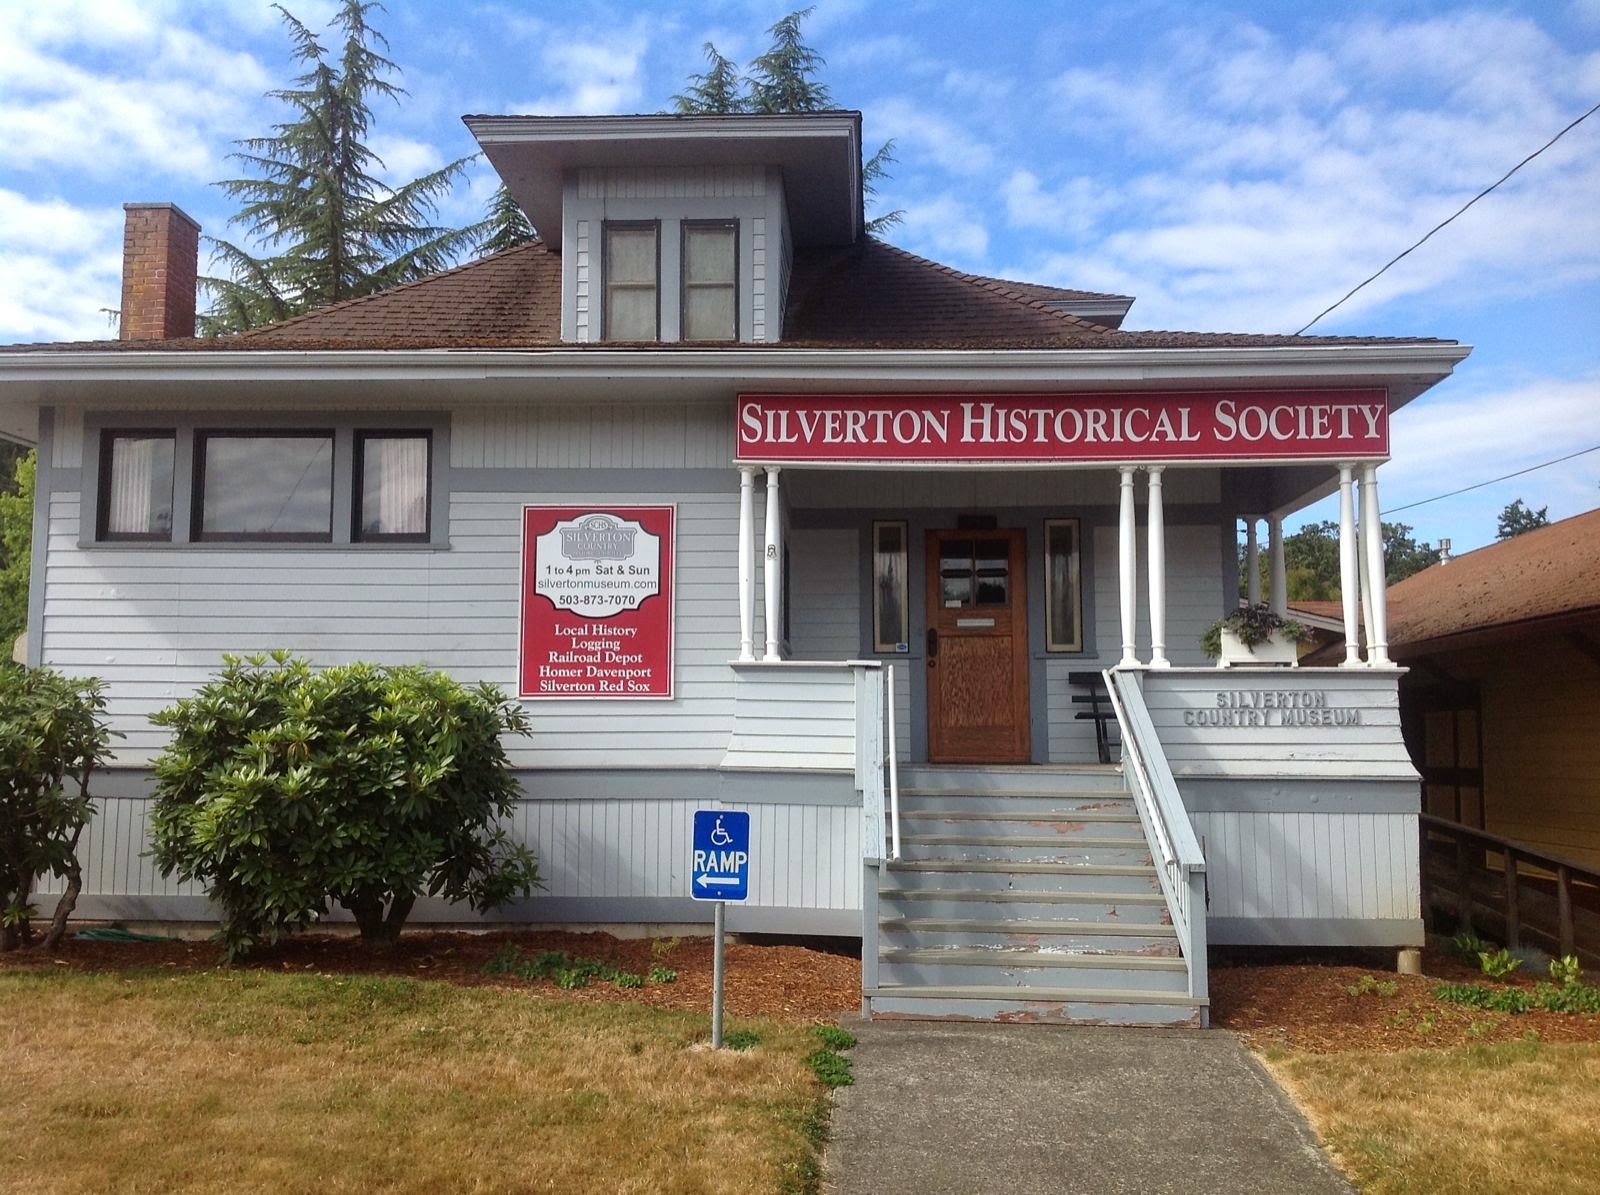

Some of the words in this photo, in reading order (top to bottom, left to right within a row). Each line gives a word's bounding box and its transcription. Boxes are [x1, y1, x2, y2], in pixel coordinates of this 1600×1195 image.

[741, 403, 950, 444] SILVERTON
[960, 402, 1200, 443] HISTORICAL
[1213, 400, 1384, 441] SOCIETY
[566, 533, 631, 541] SILVERTON
[546, 565, 551, 575] 1
[555, 567, 564, 575] to
[566, 565, 573, 575] 4
[575, 568, 590, 576] pm
[595, 565, 613, 575] Sat
[617, 565, 625, 575] &
[628, 565, 650, 575] Sun
[538, 579, 657, 589] silvertonmuseum.com
[559, 595, 635, 605] 503-873-7070
[555, 624, 588, 636] Local
[592, 624, 637, 638] History
[572, 637, 621, 651] Logging
[549, 651, 600, 663] Railroad
[605, 651, 643, 665] Depot
[539, 665, 582, 677] Homer
[586, 665, 652, 679] Davenport
[540, 680, 595, 692] Silverton
[599, 680, 624, 692] Red
[627, 680, 650, 692] Sox
[1216, 691, 1327, 708] SILVERTON
[1184, 708, 1270, 726] COUNTRY
[1280, 708, 1362, 726] MUSEUM
[693, 849, 748, 873] RAMP
